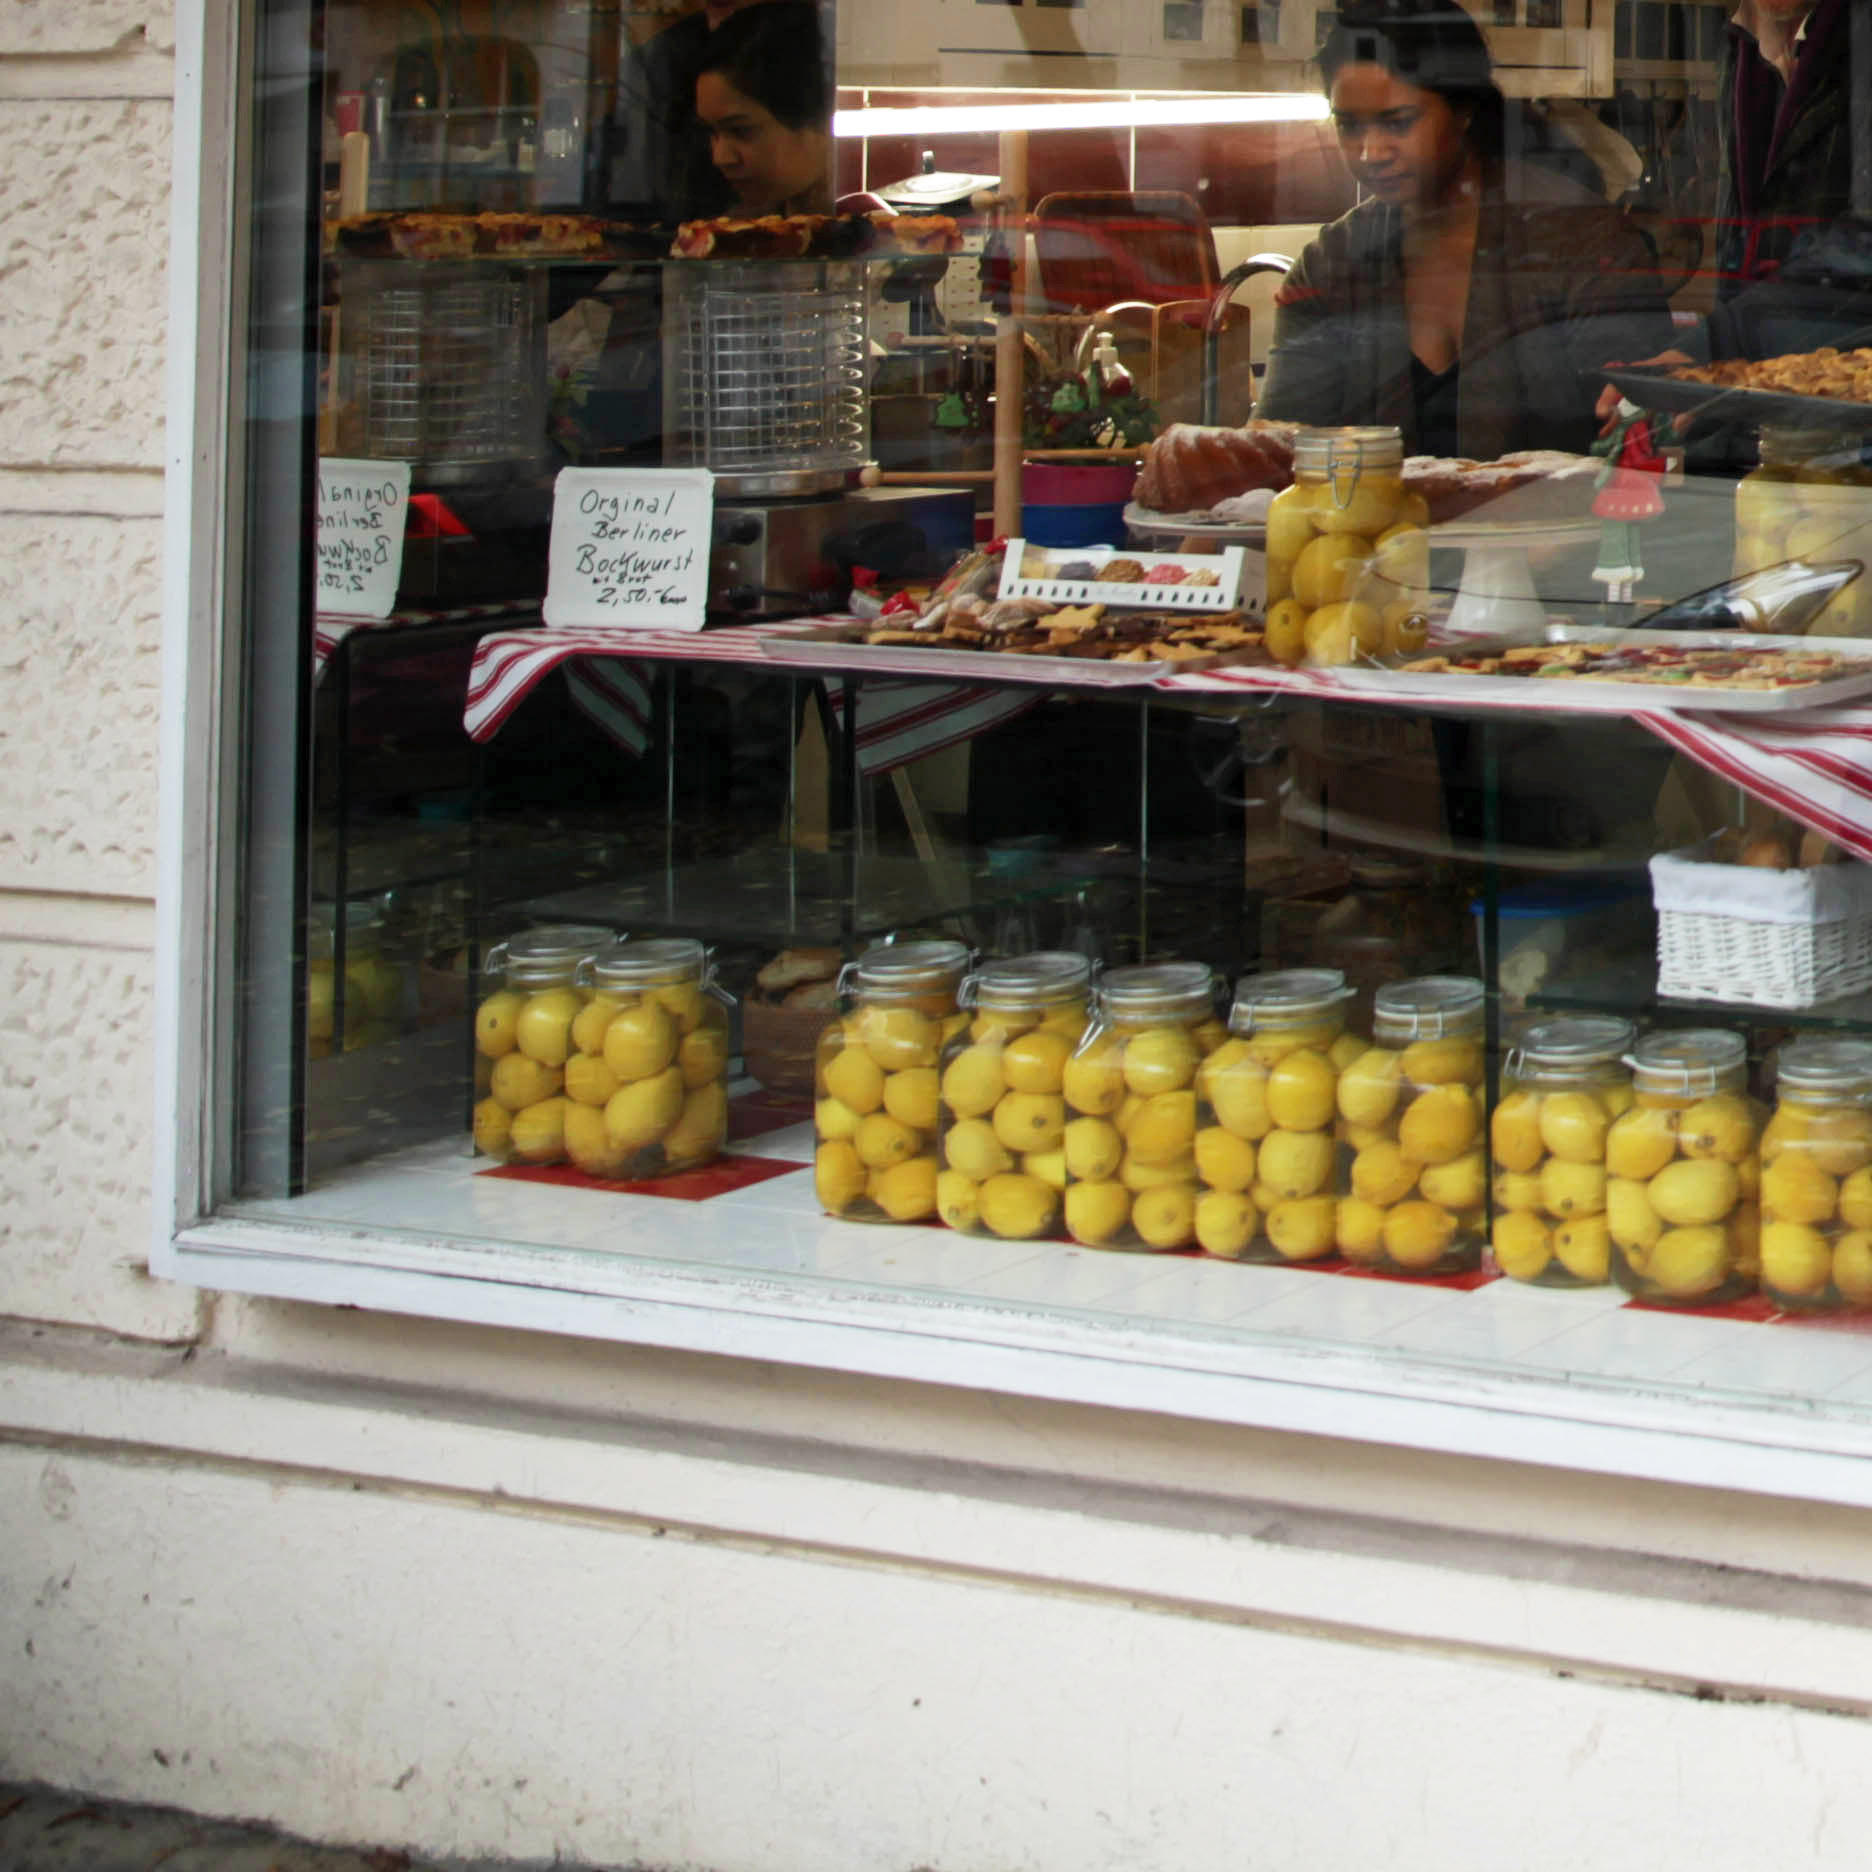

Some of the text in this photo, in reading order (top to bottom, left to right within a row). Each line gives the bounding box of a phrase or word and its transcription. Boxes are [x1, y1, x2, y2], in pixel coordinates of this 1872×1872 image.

[579, 488, 677, 522] Orginal
[591, 519, 688, 544] Berliner
[575, 542, 694, 575] Bockwurst
